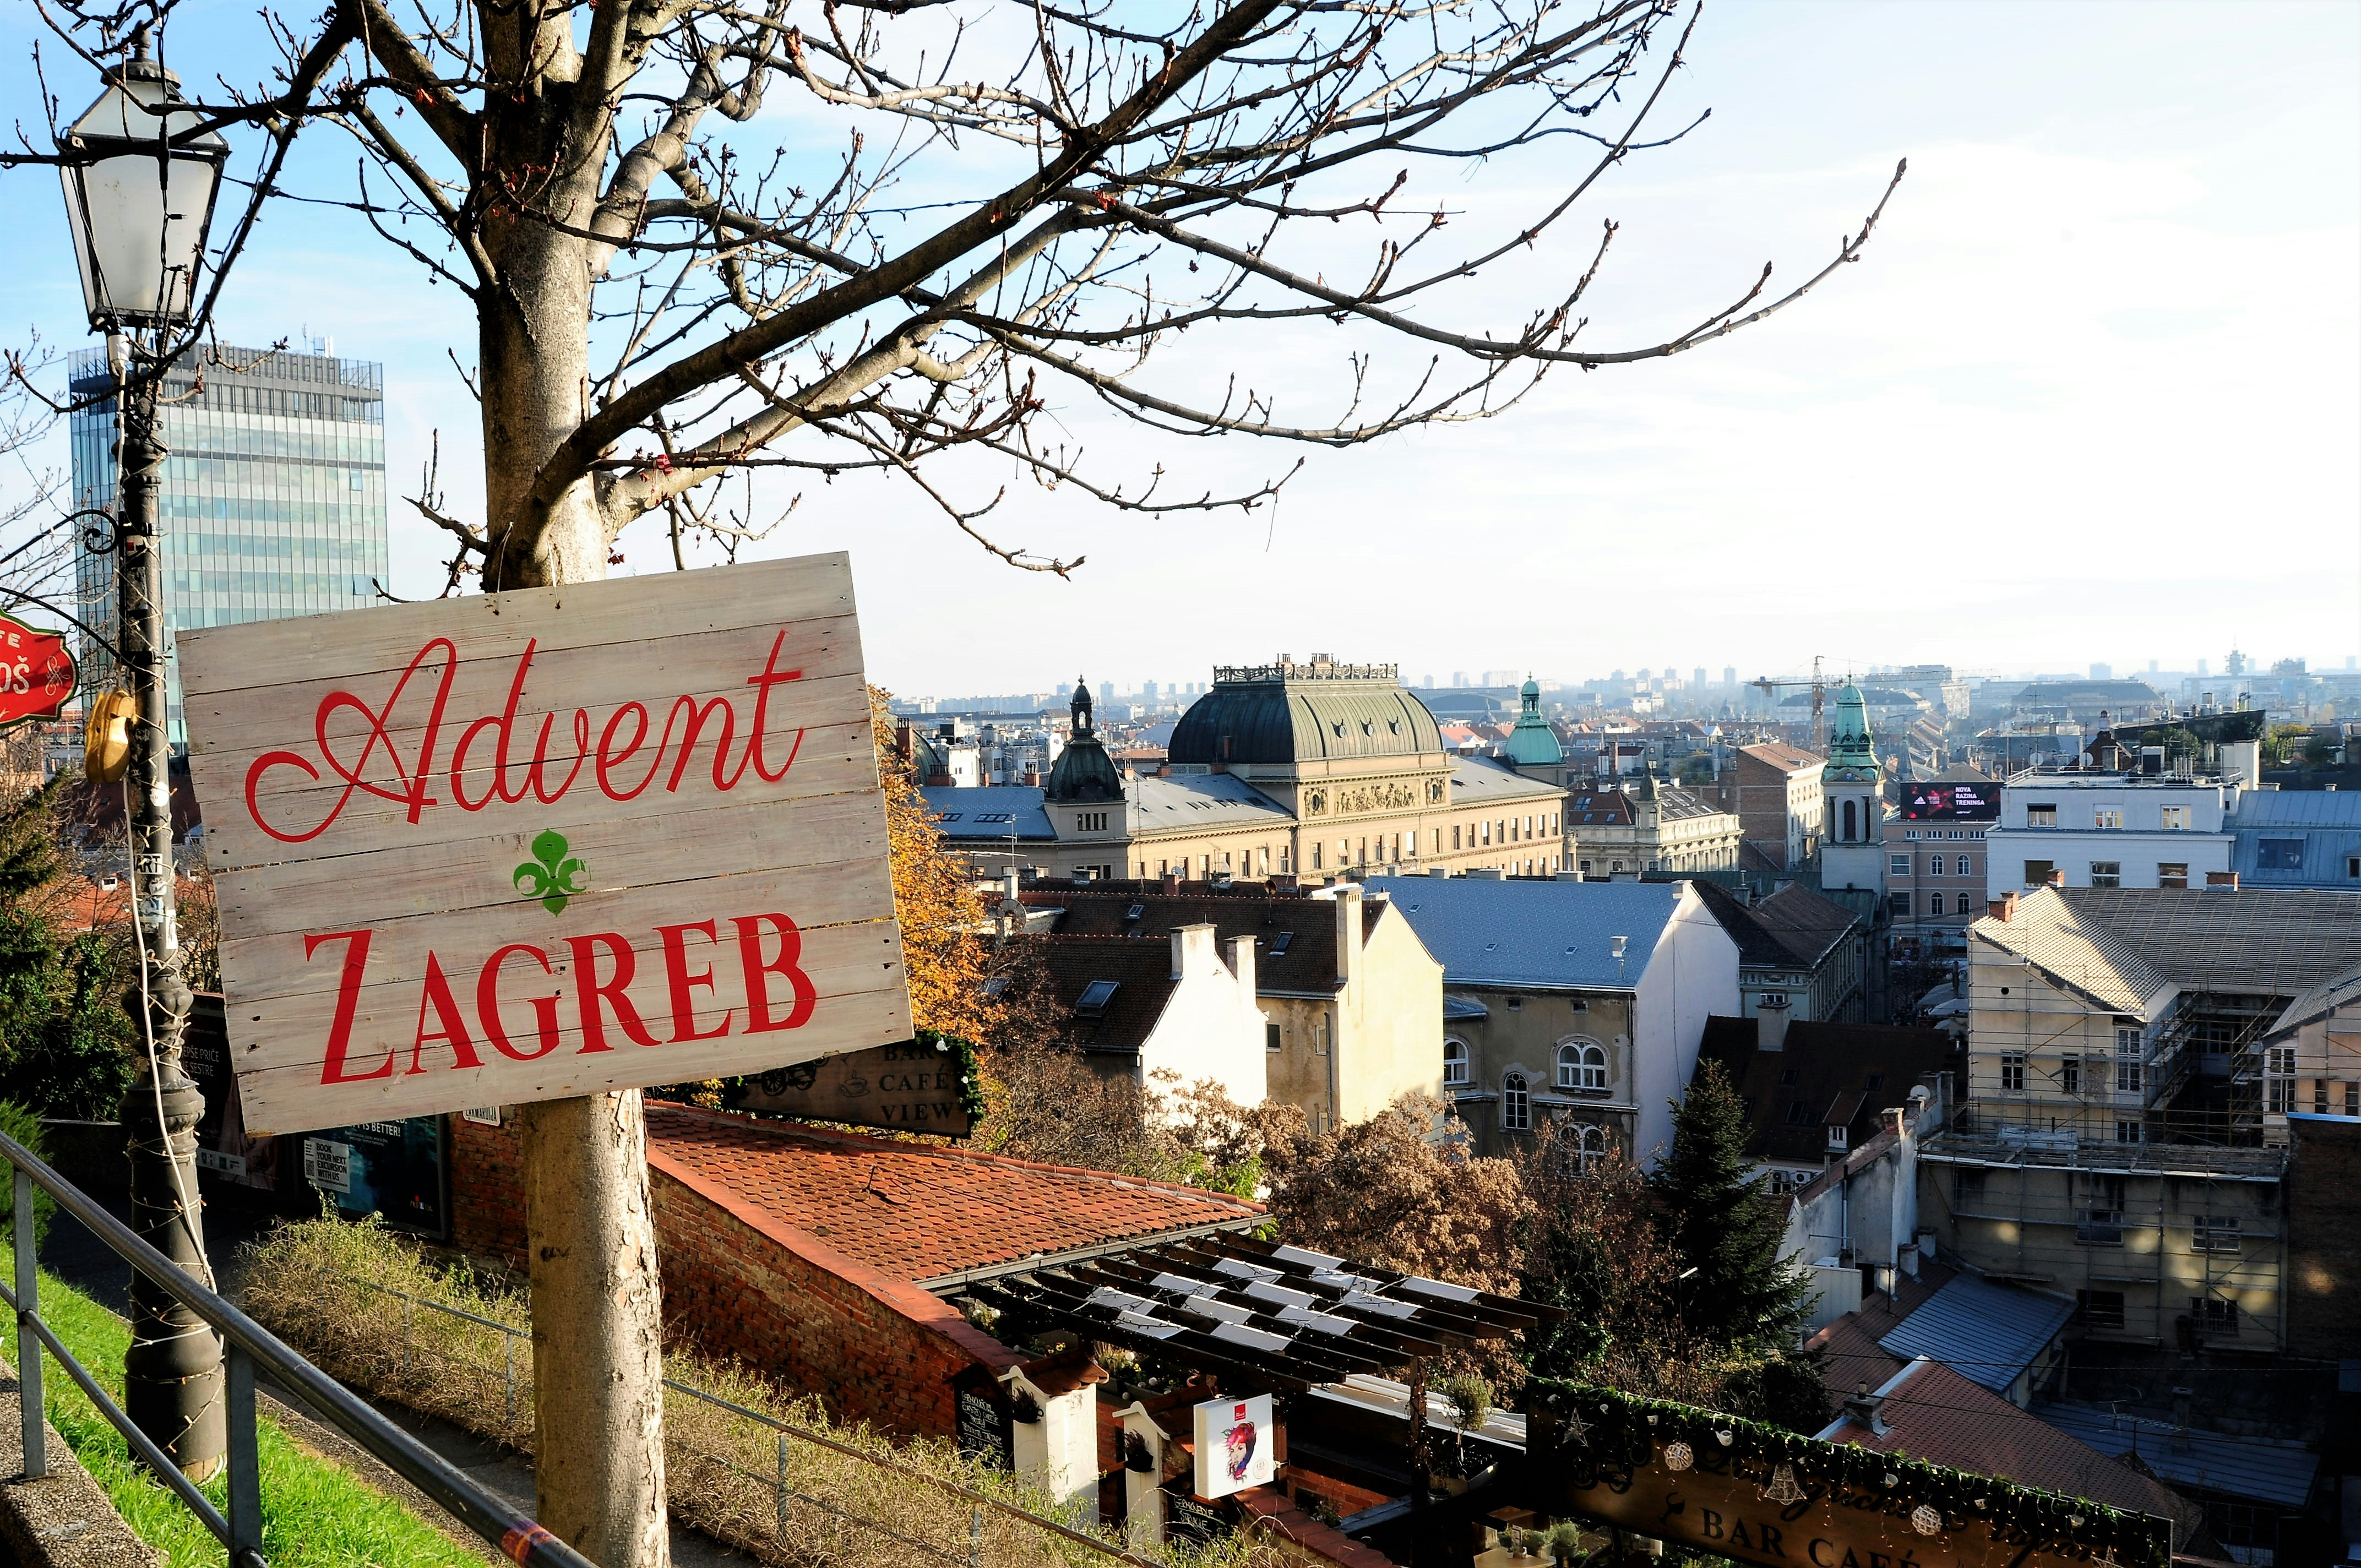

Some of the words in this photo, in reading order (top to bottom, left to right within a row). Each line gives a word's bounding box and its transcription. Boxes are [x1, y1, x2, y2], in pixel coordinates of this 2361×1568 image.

[246, 631, 804, 842] Advent
[304, 913, 817, 1084] ZAGREB
[879, 1063, 949, 1091] CAFÉ
[880, 1103, 954, 1122] VIEW
[371, 1123, 401, 1137] BETTER!
[316, 1143, 331, 1153] BOOK
[317, 1152, 331, 1162] YOUR
[332, 1155, 346, 1164] NEXT
[317, 1160, 347, 1174] EXCURSION
[317, 1169, 331, 1179] WITH
[332, 1171, 340, 1180] US
[1700, 1507, 1786, 1557] BAR
